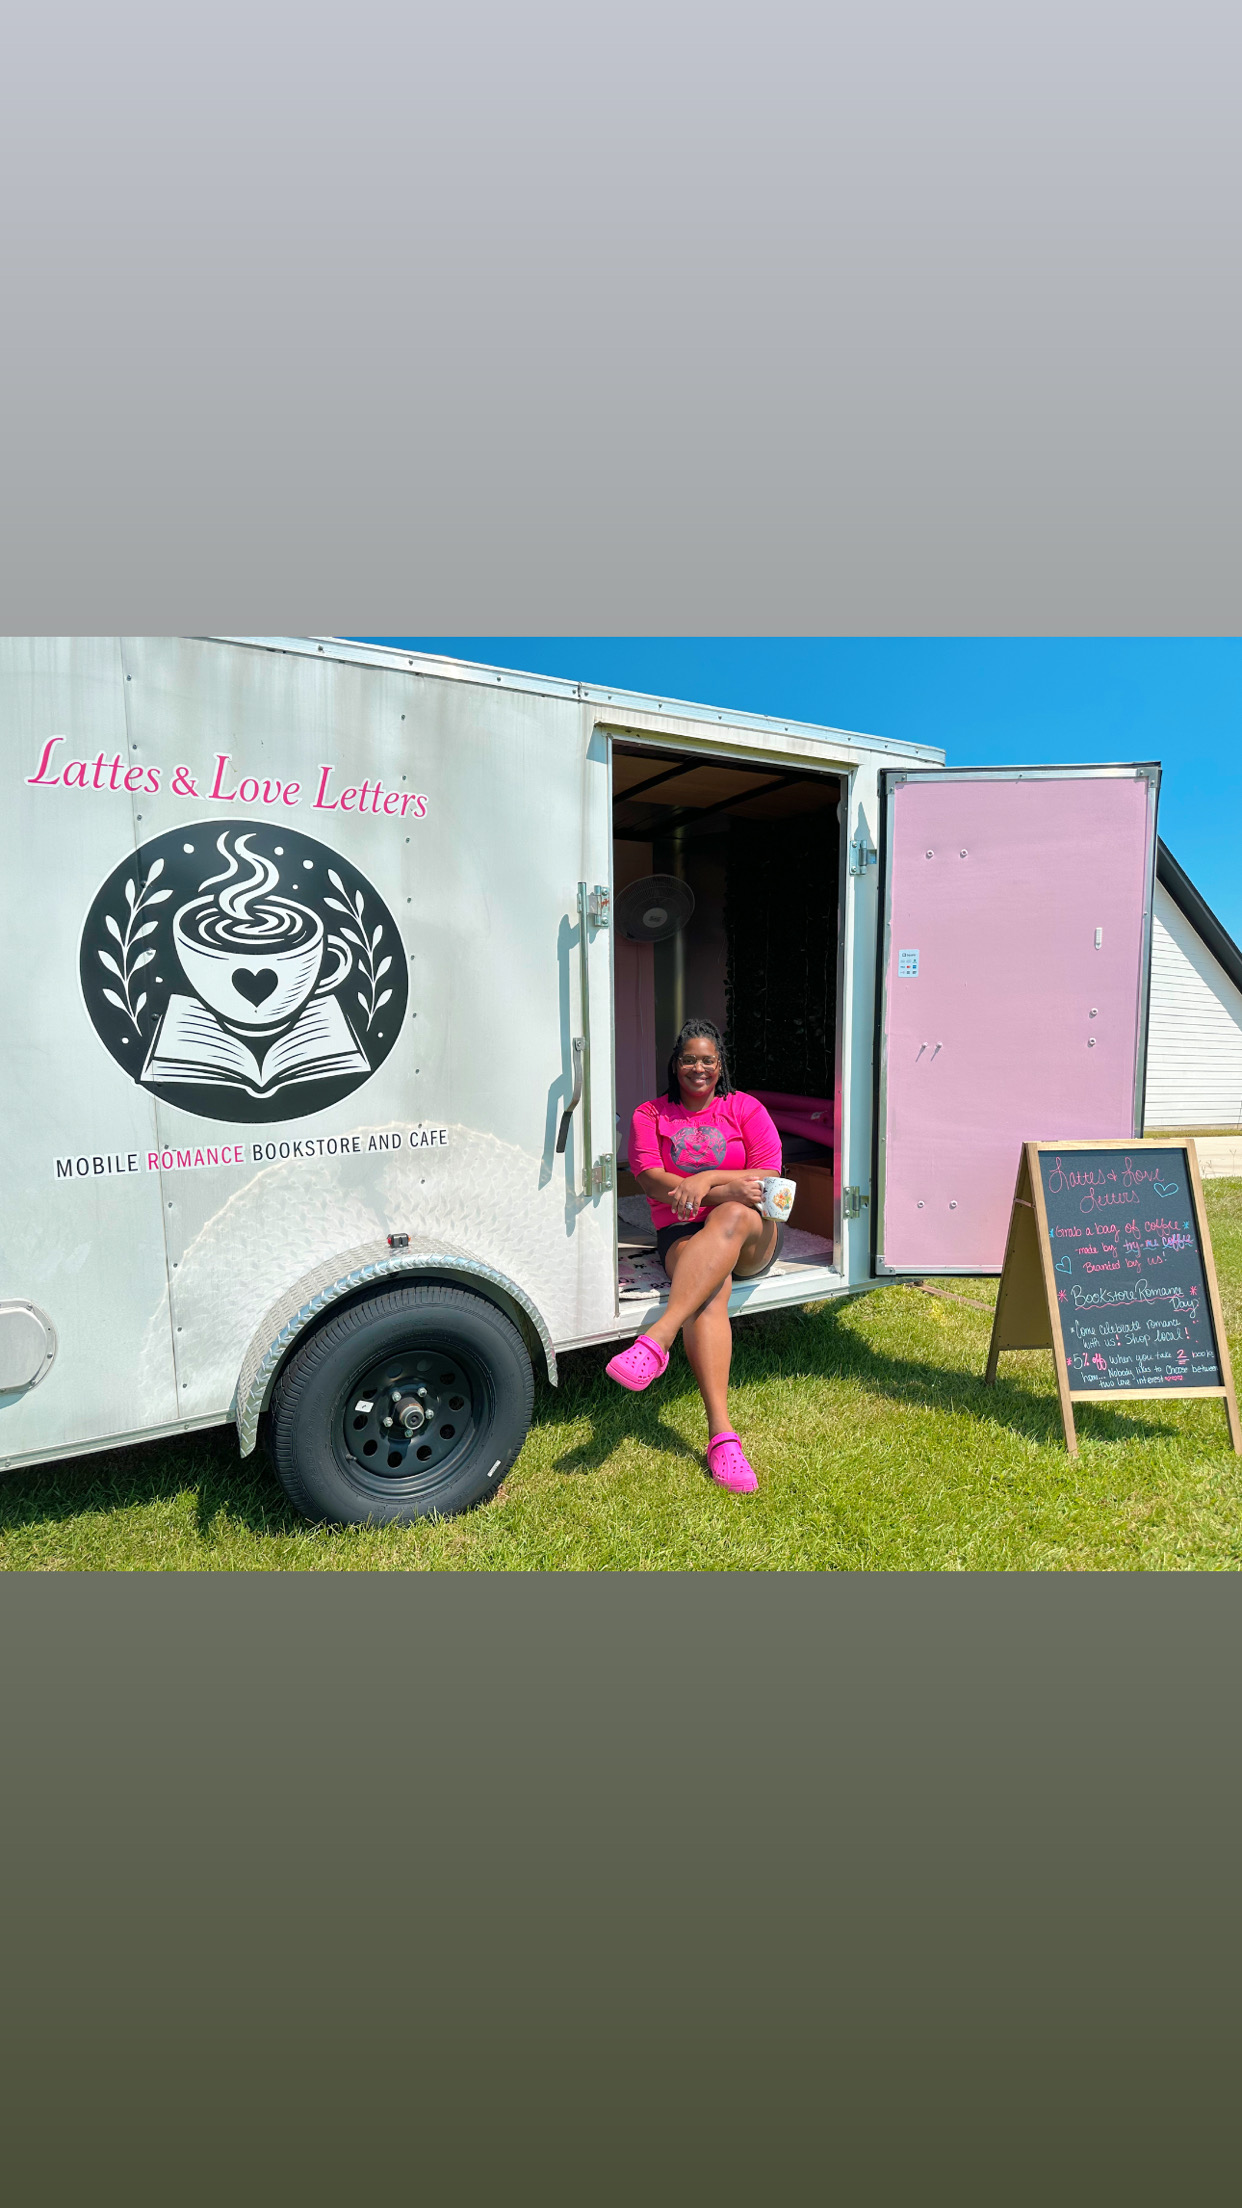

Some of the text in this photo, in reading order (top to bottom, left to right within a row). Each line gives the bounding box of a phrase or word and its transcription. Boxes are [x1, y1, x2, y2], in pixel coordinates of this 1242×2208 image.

[27, 737, 428, 818] Lattes & Love Letters
[56, 1129, 448, 1177] MOBILE ROMANCE BOOKSTORE AND CAFE
[1049, 1157, 1106, 1193] Lattes
[1122, 1157, 1164, 1187] Love
[1080, 1187, 1139, 1213] Letters
[1056, 1225, 1082, 1238] Grab
[1095, 1223, 1120, 1242] bag
[1125, 1219, 1141, 1240] of
[1144, 1218, 1181, 1237] coffee
[1102, 1243, 1117, 1258] by
[1125, 1258, 1141, 1273] by
[1071, 1285, 1137, 1307] Bookstore
[1169, 1296, 1199, 1318] Day
[1073, 1353, 1090, 1370] 5%
[1092, 1353, 1107, 1370] off
[1135, 1353, 1154, 1368] you
[1155, 1351, 1172, 1360] take
[1177, 1349, 1187, 1359] 2
[1108, 1368, 1135, 1380] Nobody
[1135, 1366, 1152, 1375] likes
[1099, 1380, 1115, 1389] two
